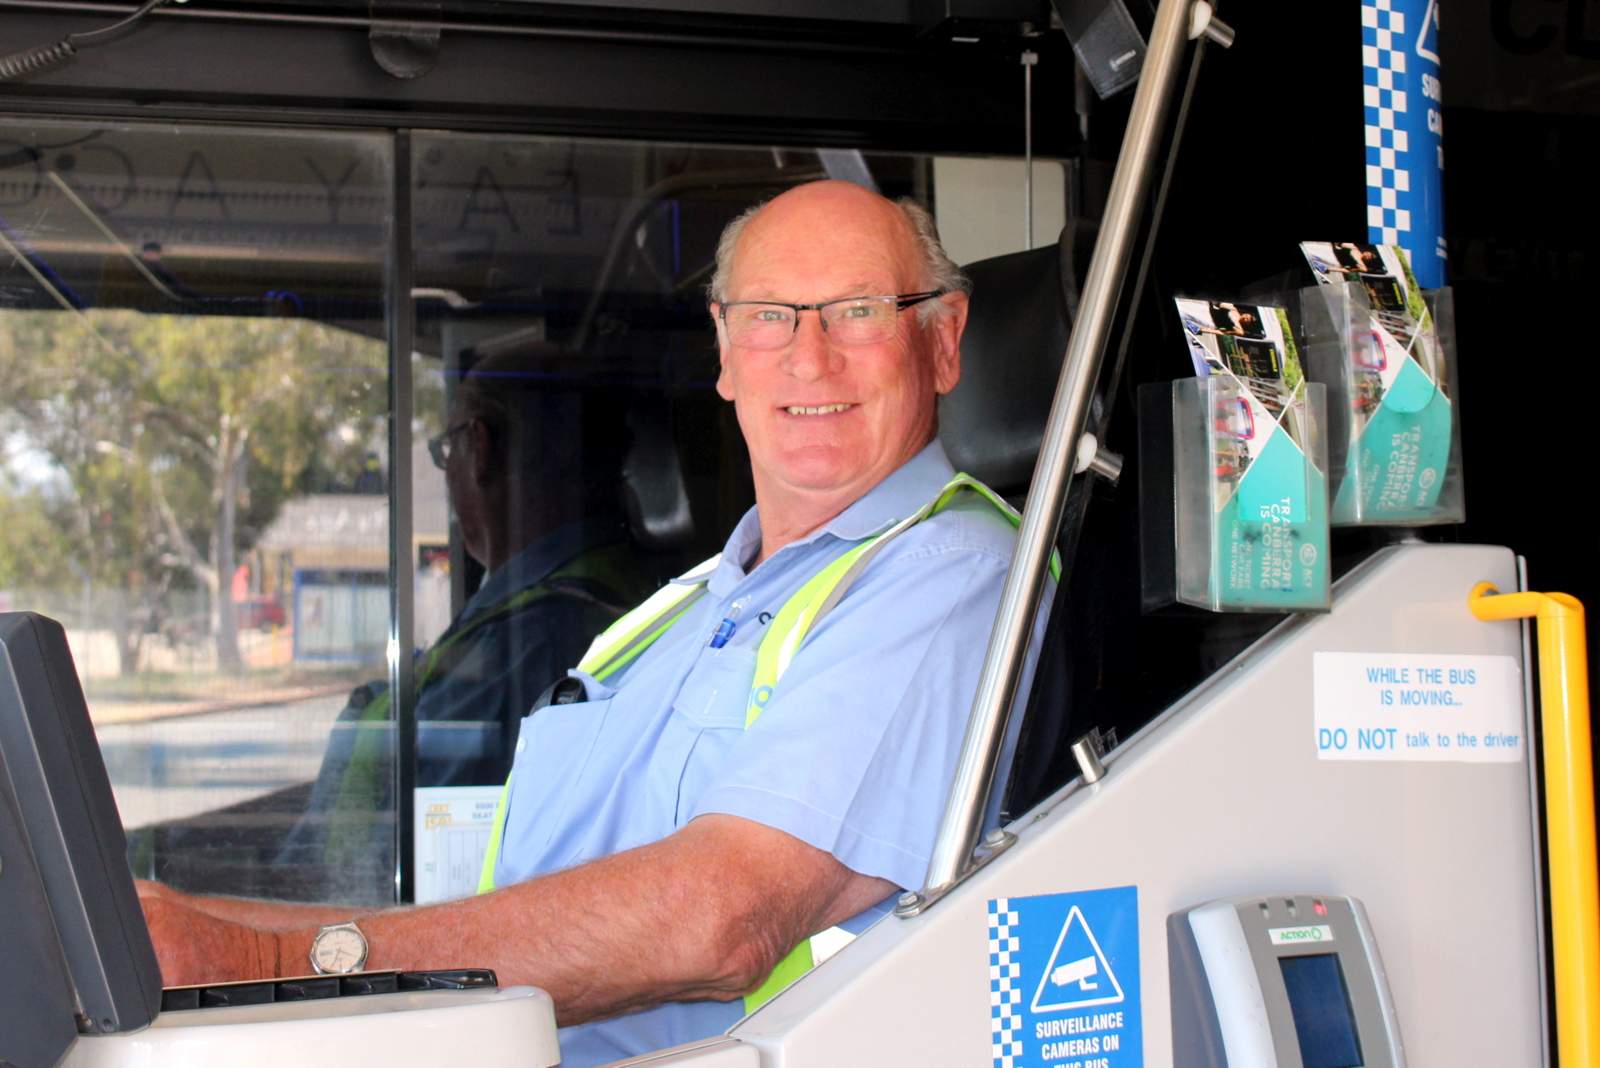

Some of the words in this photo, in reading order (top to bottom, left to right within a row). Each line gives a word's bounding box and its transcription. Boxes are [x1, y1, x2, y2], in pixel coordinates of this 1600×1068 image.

[1392, 433, 1401, 448] IS
[1259, 505, 1270, 519] IS
[1261, 522, 1272, 588] COMING
[1270, 503, 1281, 589] CANBERRA
[1366, 667, 1409, 684] WHILE
[1416, 668, 1443, 684] THE
[1449, 669, 1476, 685] BUS
[1380, 690, 1394, 705] IS
[1318, 728, 1347, 750] DO
[1358, 728, 1397, 750] NOT
[1406, 732, 1430, 747] talk
[1437, 733, 1450, 747] to
[1457, 733, 1477, 747] the
[1484, 734, 1519, 747] driver
[1035, 1011, 1124, 1039] SURVEILLANCE
[1041, 1036, 1100, 1060] CAMERAS
[1102, 1034, 1120, 1052] ON
